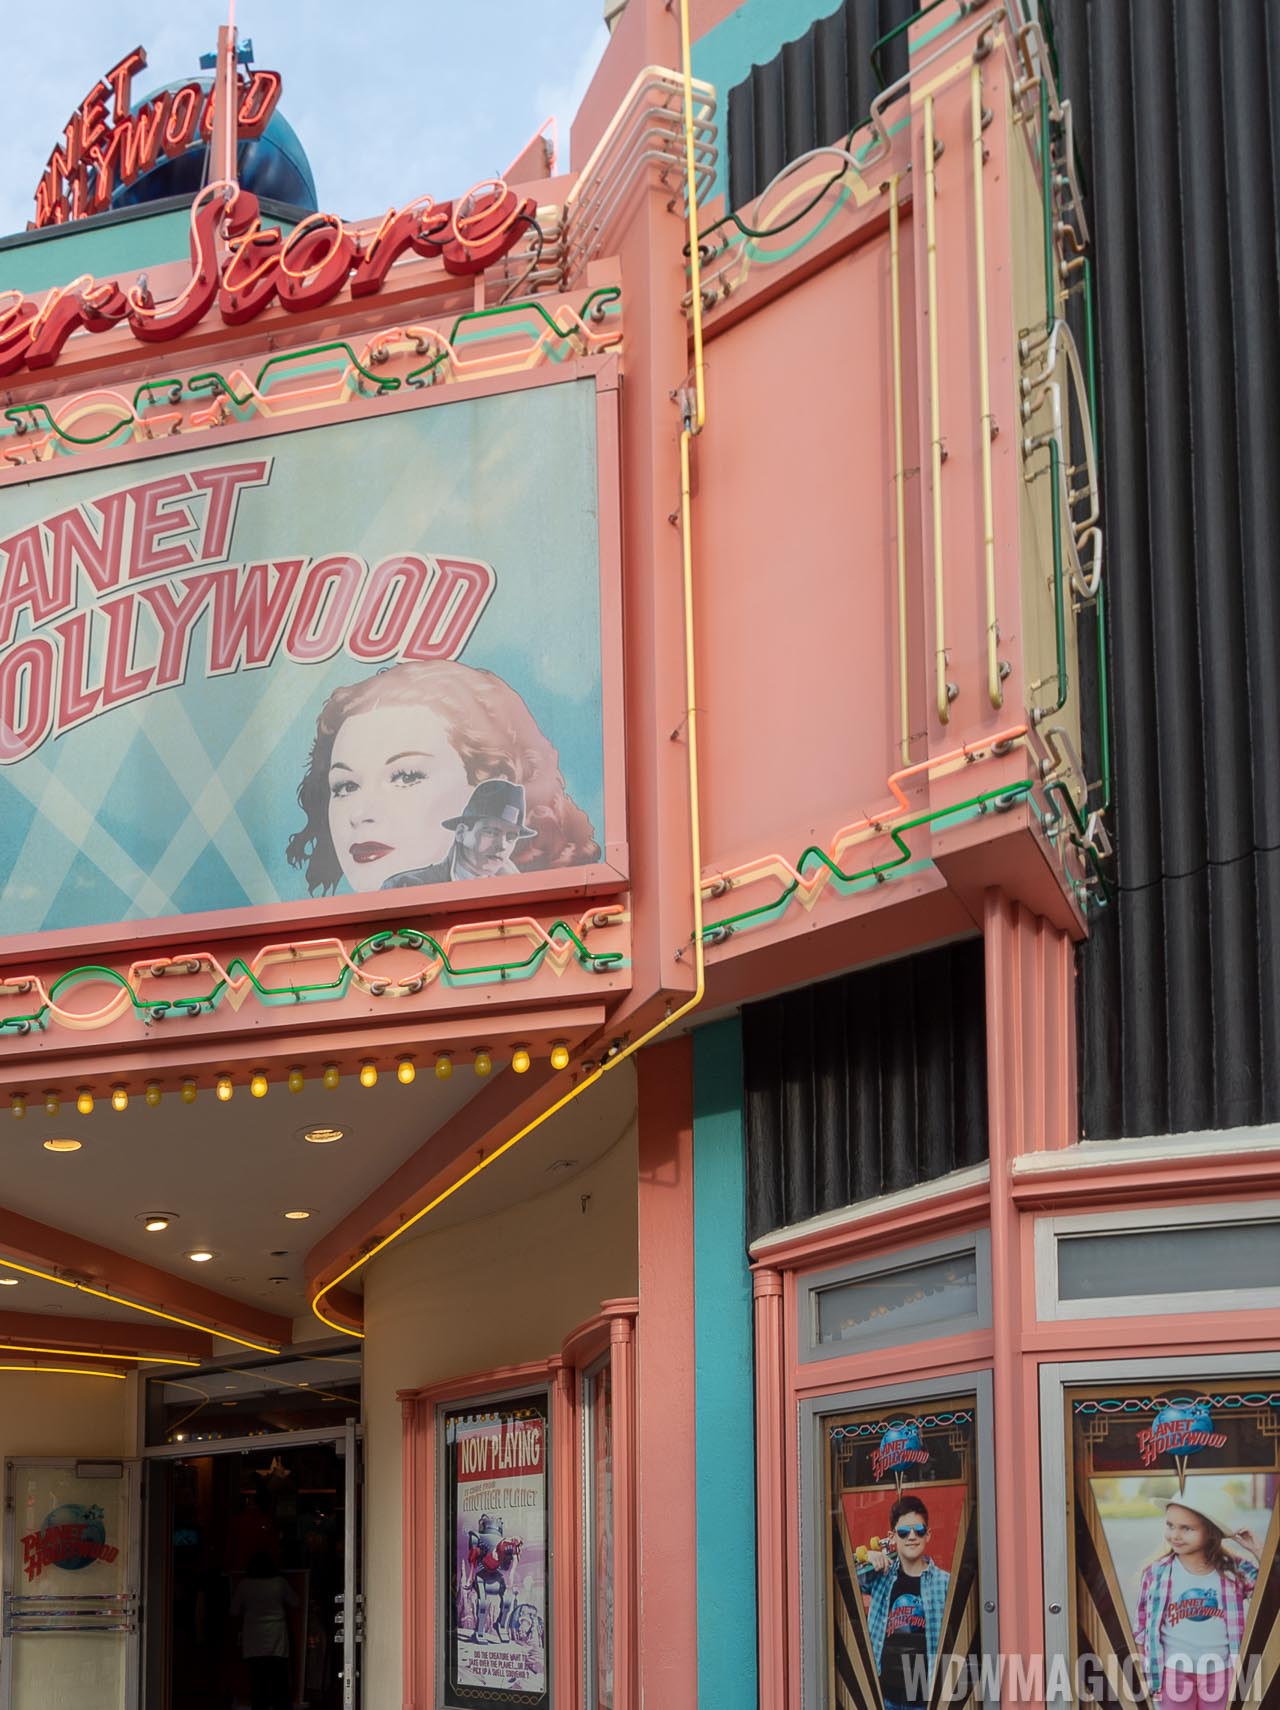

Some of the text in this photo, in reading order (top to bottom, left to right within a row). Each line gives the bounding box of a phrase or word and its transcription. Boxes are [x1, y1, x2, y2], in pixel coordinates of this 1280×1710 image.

[128, 178, 538, 343] Store
[461, 1428, 540, 1474] NOW PLAYING
[1136, 1418, 1195, 1453] PLANET
[1140, 1430, 1228, 1468] HOLLYWOOD
[870, 1438, 908, 1470] PLANET
[873, 1448, 929, 1482] HOLLYWOOD
[20, 1523, 89, 1564] PLANET
[23, 1542, 119, 1582] HOLLYWOOD
[888, 1605, 915, 1619] LANET
[1168, 1598, 1207, 1618] PLANET
